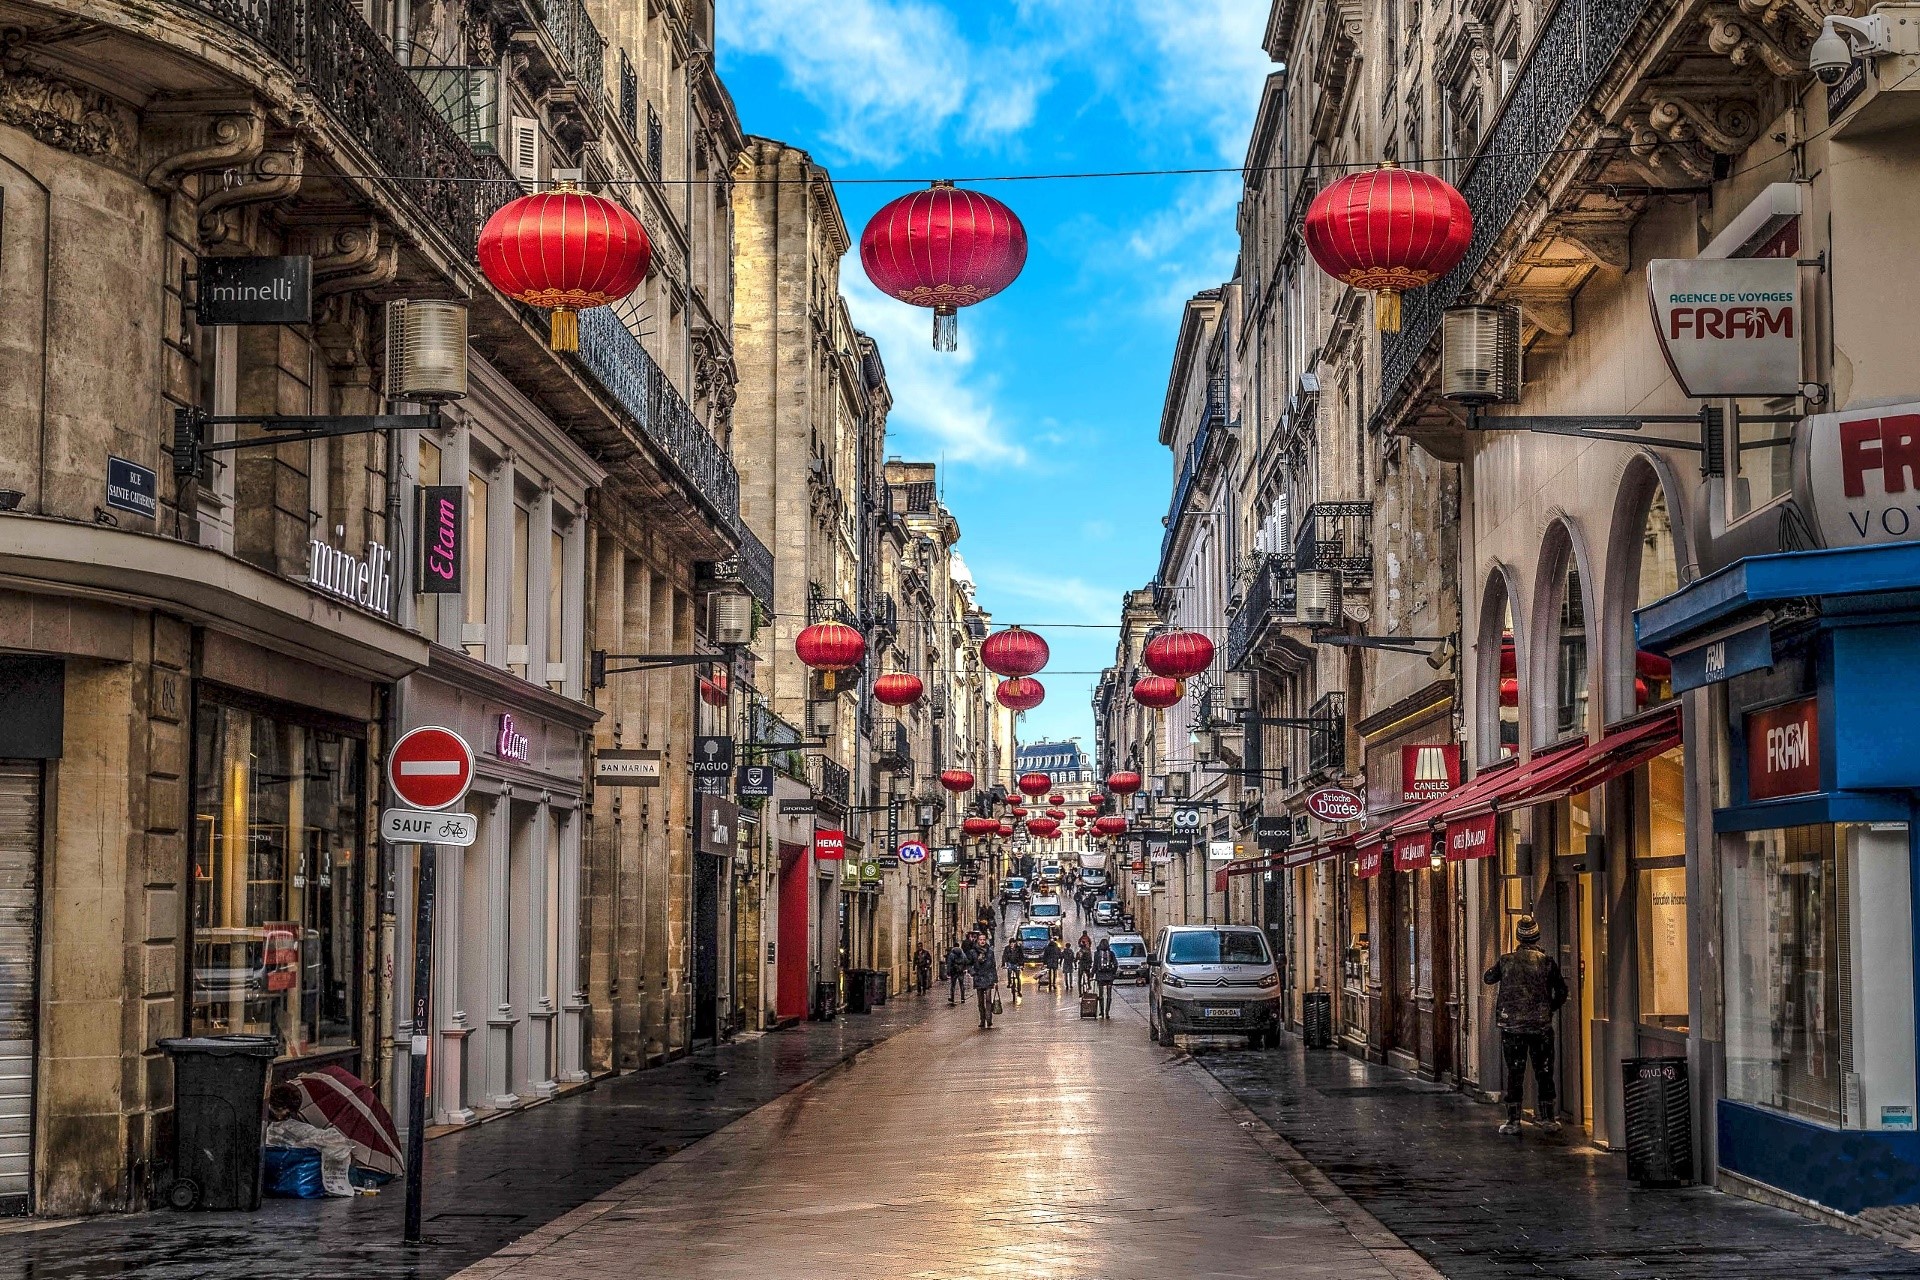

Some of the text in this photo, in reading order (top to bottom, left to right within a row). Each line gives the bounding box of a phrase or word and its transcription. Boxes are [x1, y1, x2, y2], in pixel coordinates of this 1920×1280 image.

[213, 278, 292, 301] minelli
[1669, 292, 1793, 303] AGENCE DE VOYAGES
[1670, 306, 1794, 340] FRAM
[129, 471, 142, 486] RUE
[109, 484, 156, 510] SAINTE CATHERINE
[1848, 504, 1920, 539] VO
[429, 498, 456, 580] Etam
[310, 524, 392, 618] minelli
[501, 713, 528, 761] Etam
[1766, 720, 1810, 774] FRAM
[601, 763, 655, 773] SAN MARINA
[694, 762, 729, 771] FAGUO
[1413, 780, 1450, 790] CANELÉS
[1323, 792, 1351, 803] Brioche
[1317, 800, 1358, 815] Dorée
[1174, 808, 1199, 827] GO
[391, 818, 432, 833] SAUF
[817, 839, 843, 848] HEMA
[901, 846, 923, 859] C&A
[1152, 846, 1169, 858] H&M
